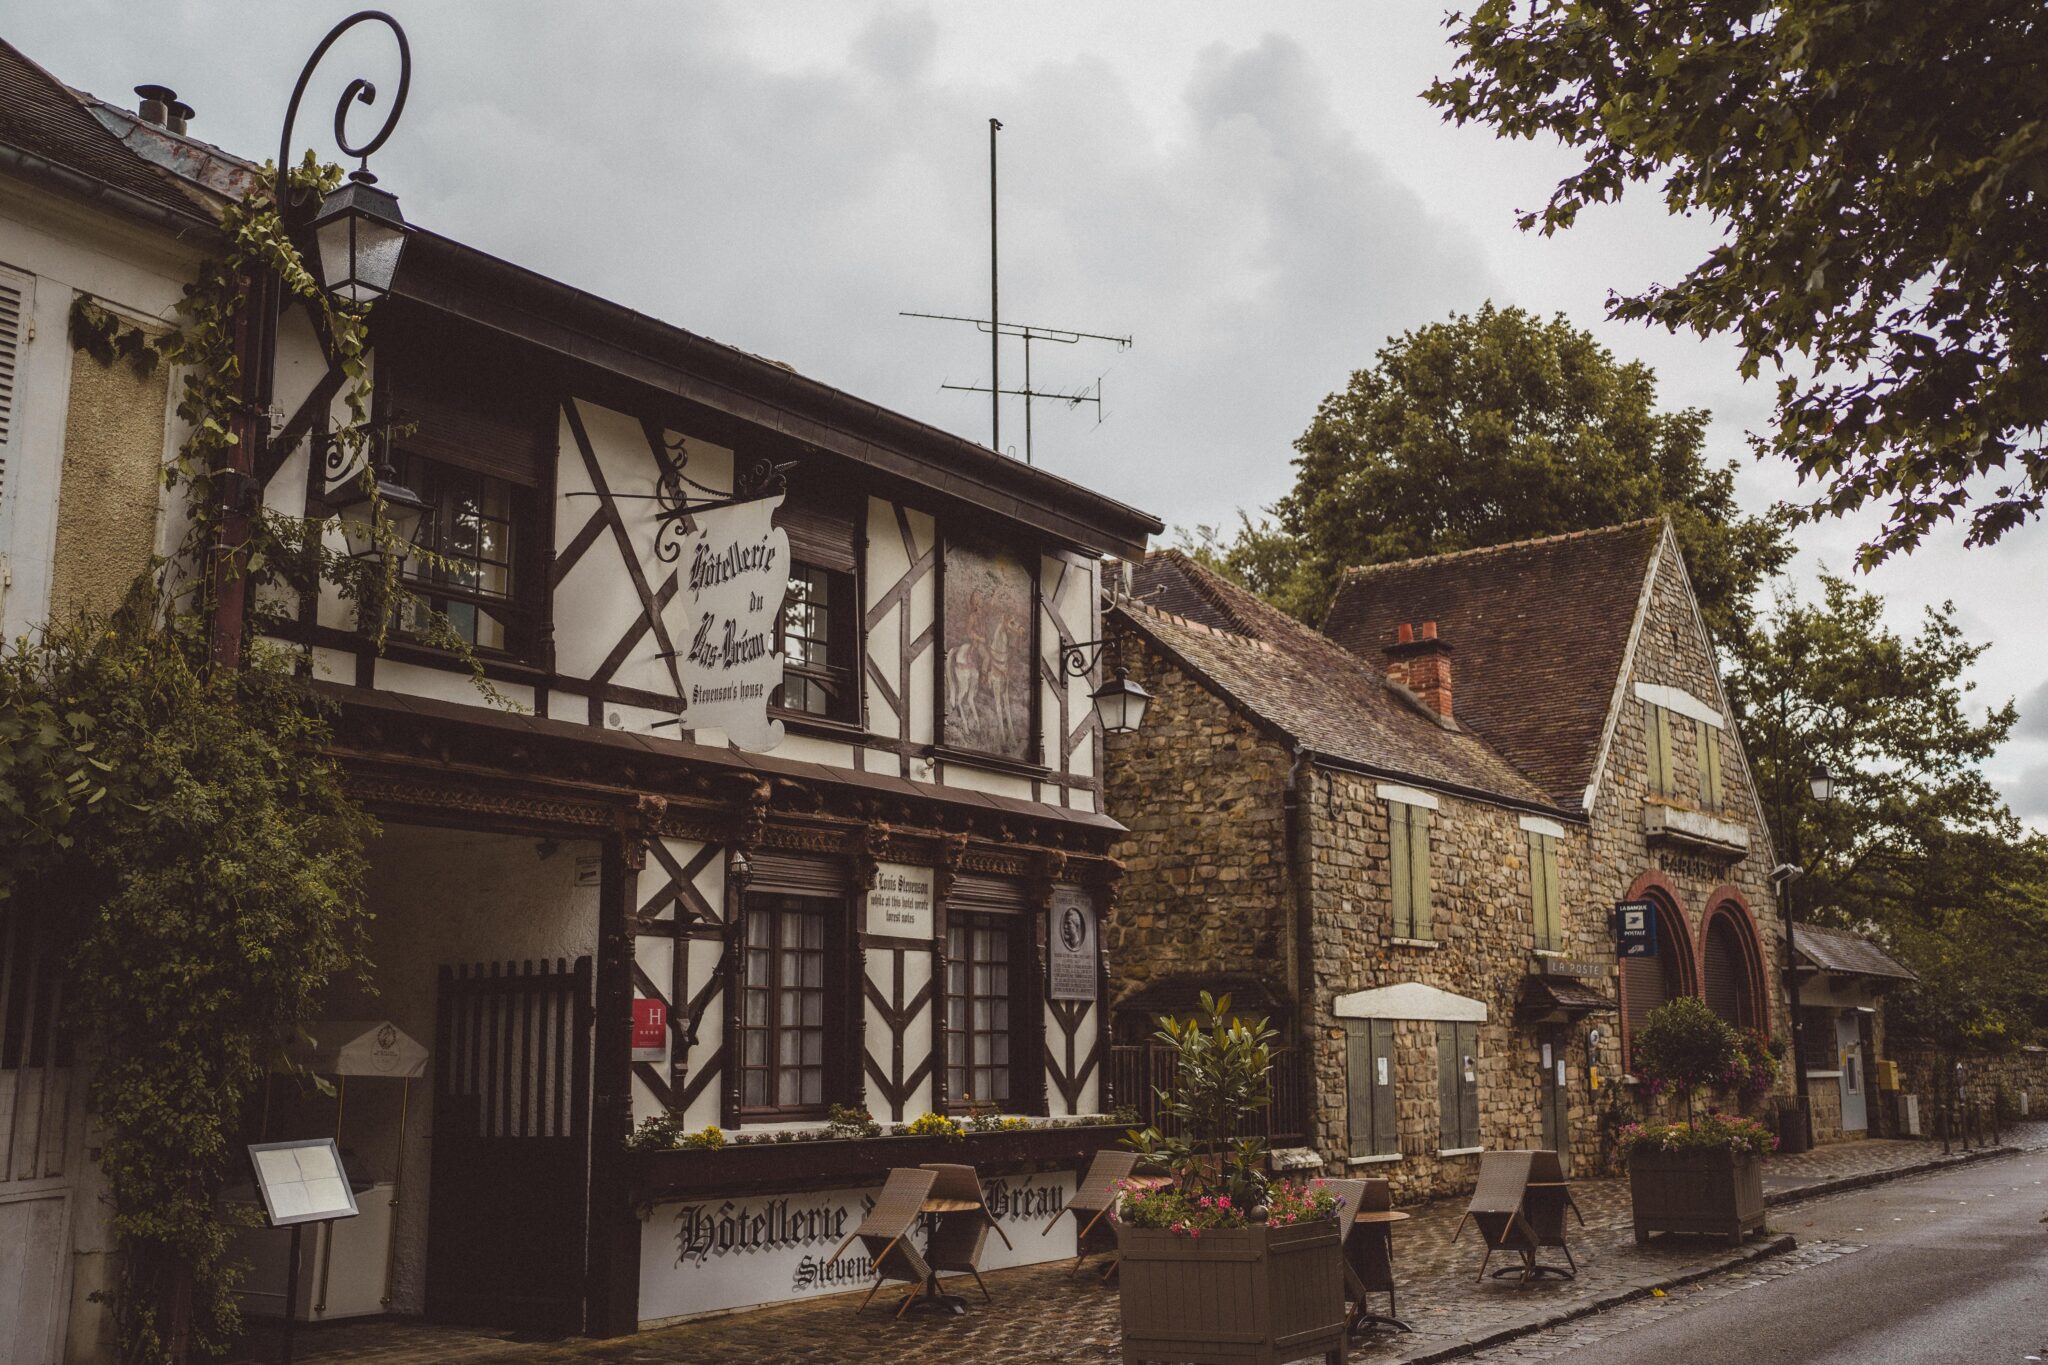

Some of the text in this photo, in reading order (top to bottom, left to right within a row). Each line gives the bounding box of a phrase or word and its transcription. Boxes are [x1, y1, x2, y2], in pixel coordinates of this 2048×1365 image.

[687, 534, 776, 604] Hôtellerie
[749, 590, 764, 612] du
[687, 611, 765, 670] Bas-Bréau
[692, 680, 764, 704] Stevenson's house
[879, 873, 928, 894] Louis Stevenson
[871, 893, 884, 906] while
[885, 896, 891, 906] at
[891, 896, 901, 908] this
[1552, 962, 1600, 975] LA POSTE
[649, 1008, 661, 1025] H
[676, 1198, 849, 1266] Hôtellerie
[796, 1255, 878, 1288] Stevens
